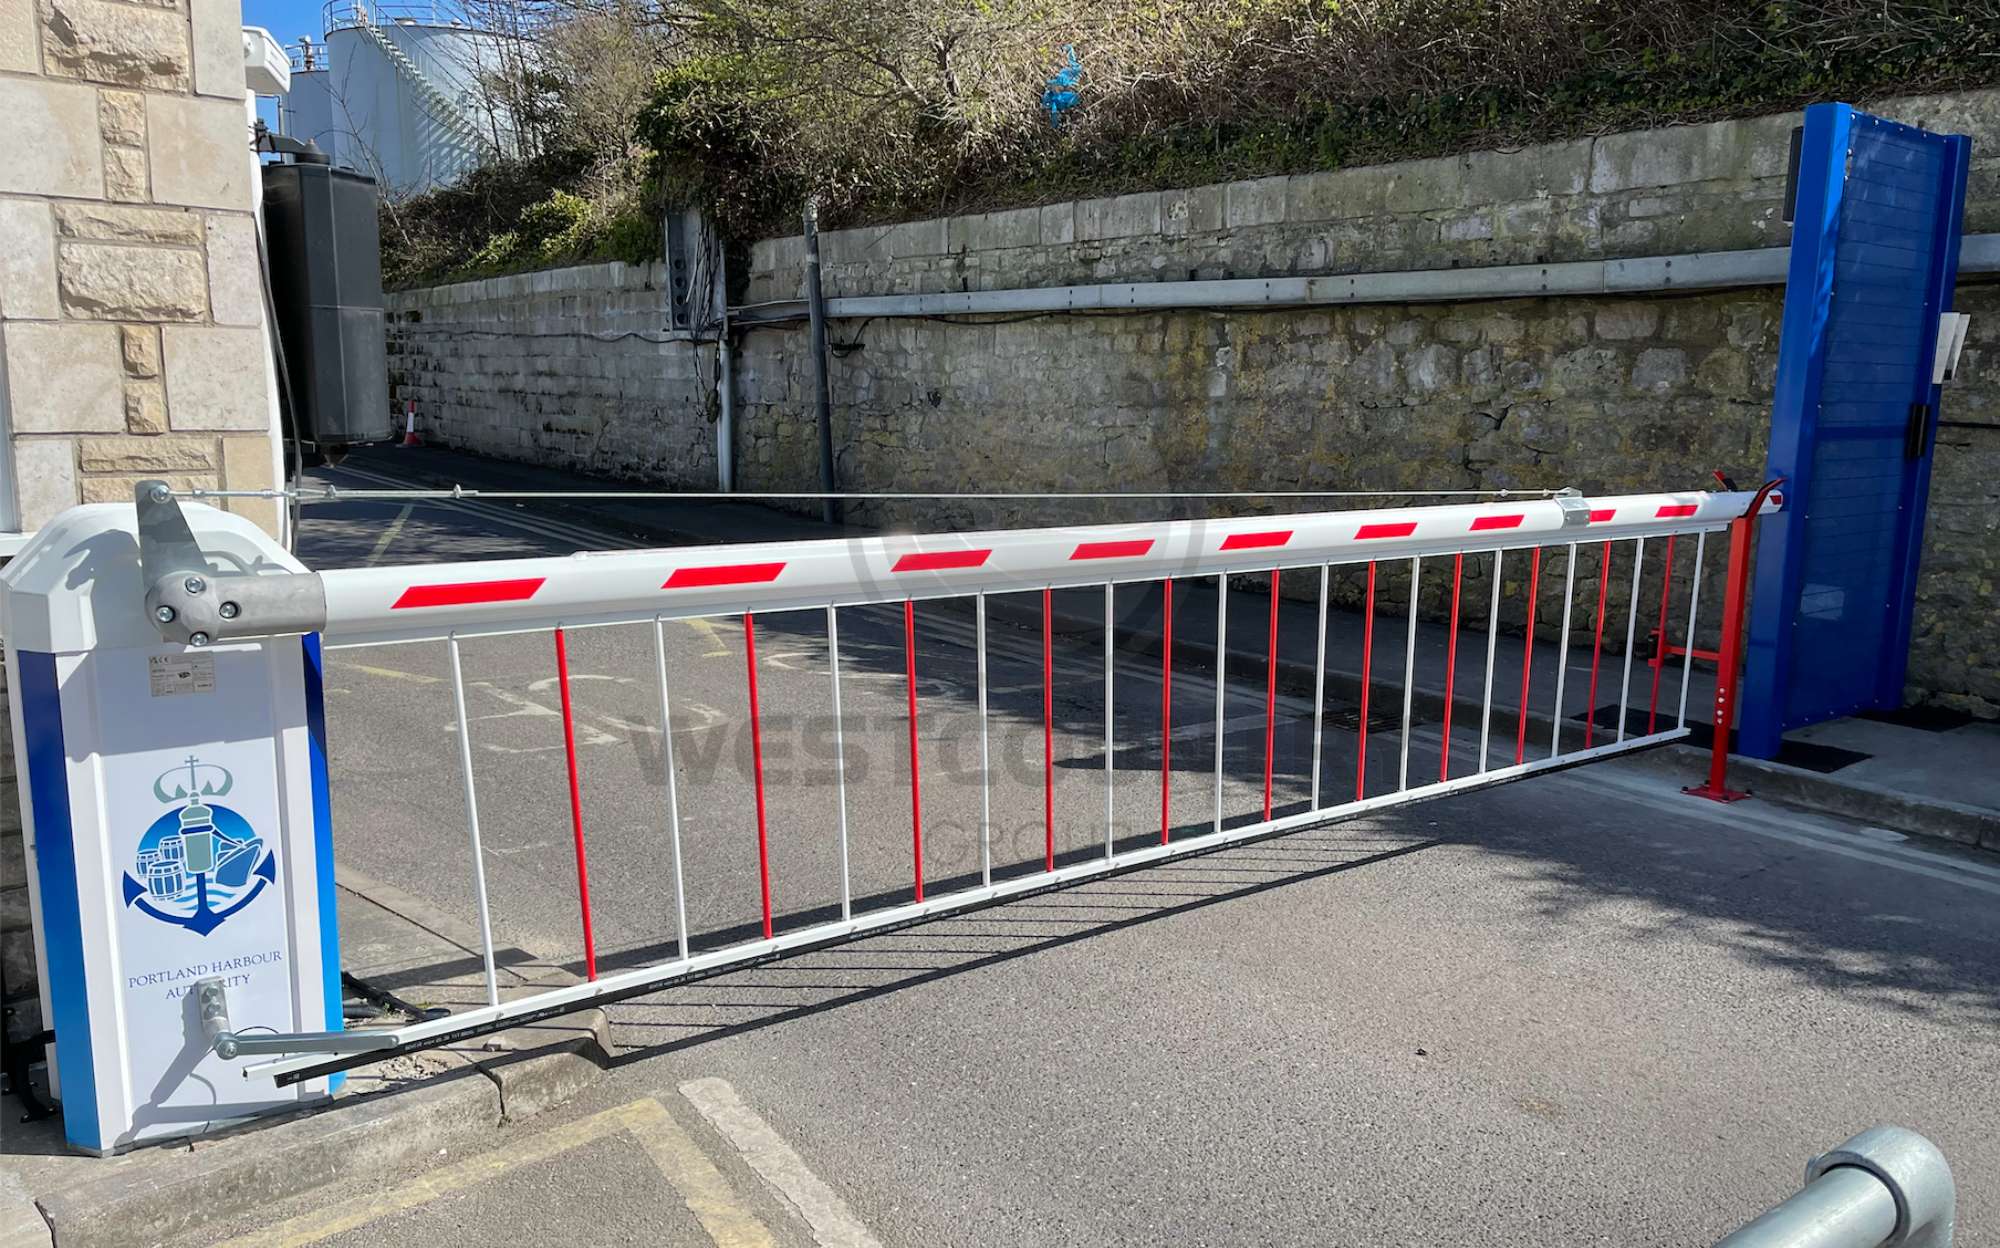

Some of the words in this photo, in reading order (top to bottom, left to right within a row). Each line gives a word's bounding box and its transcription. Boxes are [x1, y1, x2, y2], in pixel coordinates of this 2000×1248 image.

[128, 964, 208, 988] PORTLAND
[211, 951, 283, 974] HARBOUR
[166, 973, 251, 1000] AUTITY
